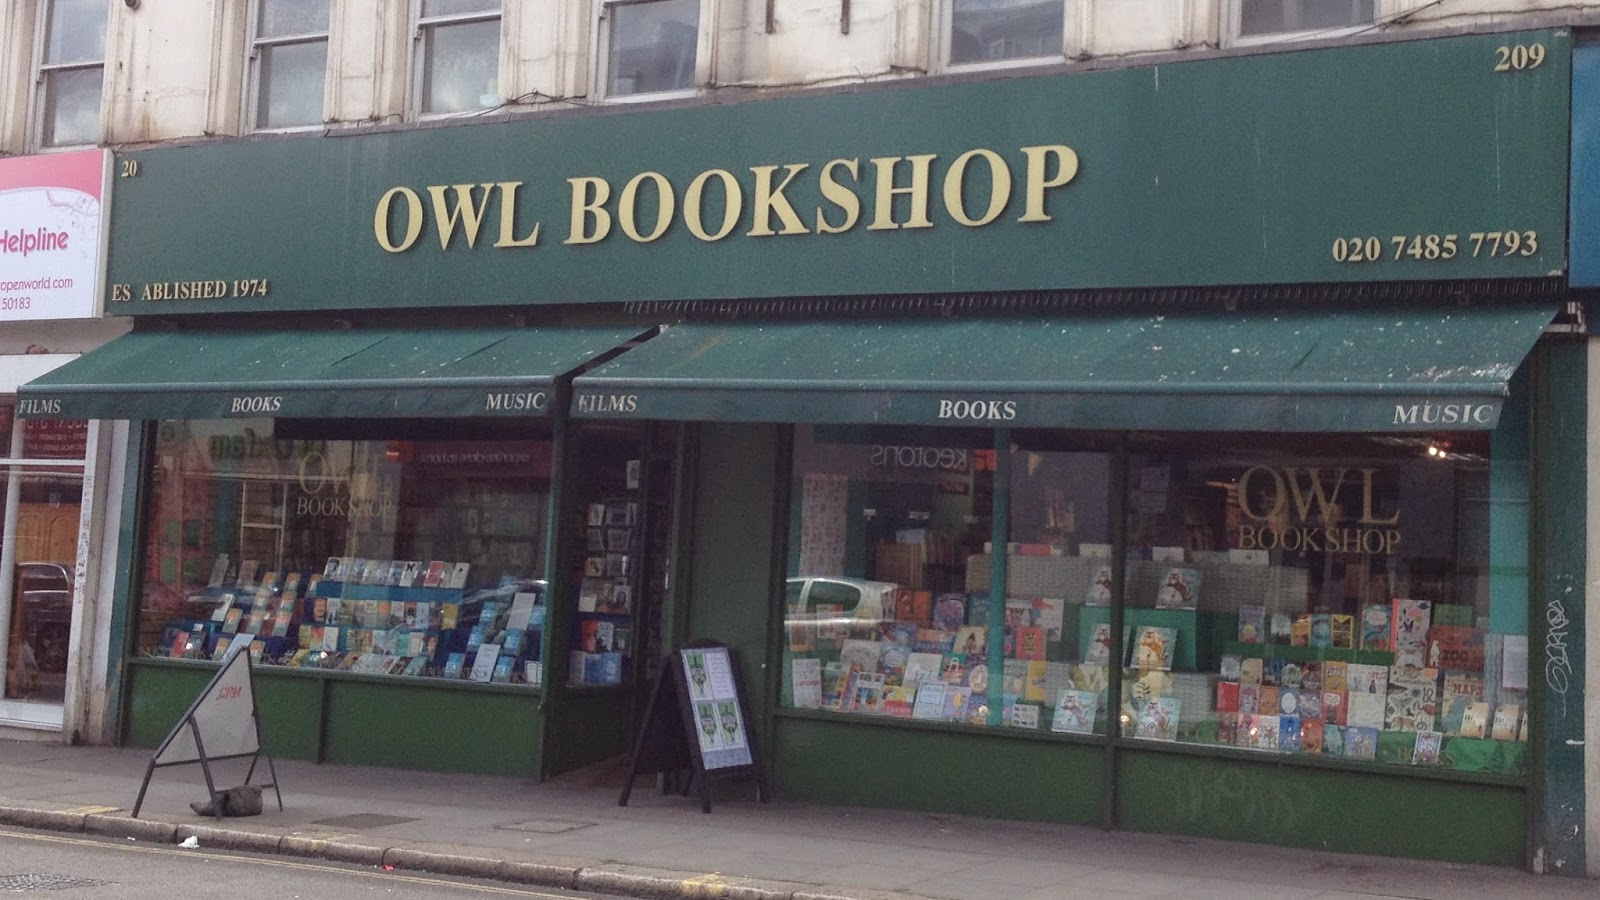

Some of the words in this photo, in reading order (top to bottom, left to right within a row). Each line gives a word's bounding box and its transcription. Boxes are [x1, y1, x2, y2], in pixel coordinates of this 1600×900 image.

[1494, 43, 1545, 72] 209
[121, 160, 137, 177] 20
[373, 180, 539, 253] OWL
[564, 144, 1079, 246] BOOKSHOP
[0, 226, 69, 257] Helpline
[1332, 237, 1381, 262] 020
[1391, 234, 1458, 261] 7485
[1469, 230, 1538, 258] 7793
[0, 276, 74, 293] openworld.com
[232, 278, 268, 297] 1974
[19, 399, 61, 414] FILMS
[231, 396, 282, 413] BOOKS
[486, 392, 546, 411] MUSIC
[577, 394, 638, 413] FILMS
[937, 399, 1017, 421] BOOKS
[1392, 403, 1494, 425] MUSIC
[1238, 466, 1401, 524] OWL
[1238, 525, 1401, 555] BOOKSHOP
